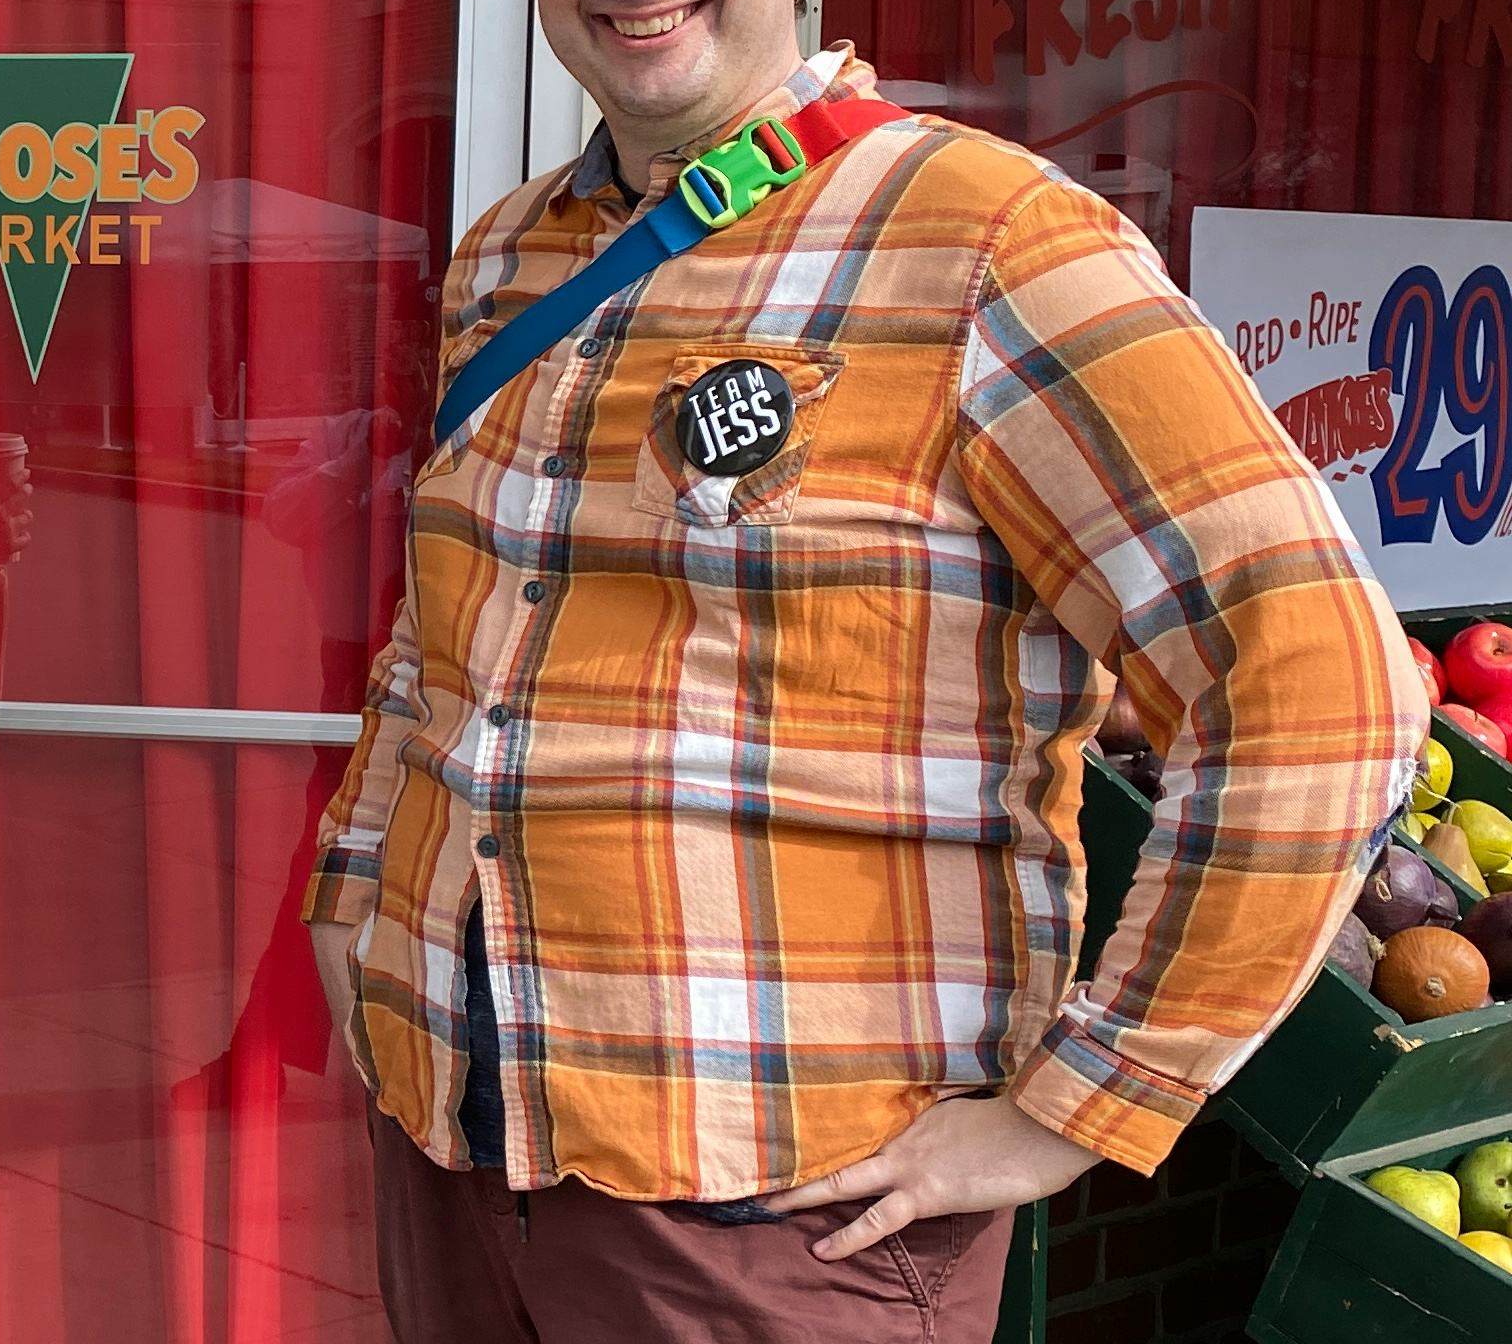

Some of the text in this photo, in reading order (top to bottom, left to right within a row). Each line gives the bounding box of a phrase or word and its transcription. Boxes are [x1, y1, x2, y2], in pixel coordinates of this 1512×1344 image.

[1236, 290, 1362, 376] RED RIPE
[689, 366, 766, 418] TEAM
[698, 389, 781, 466] JESS
[1368, 264, 1512, 546] 29
